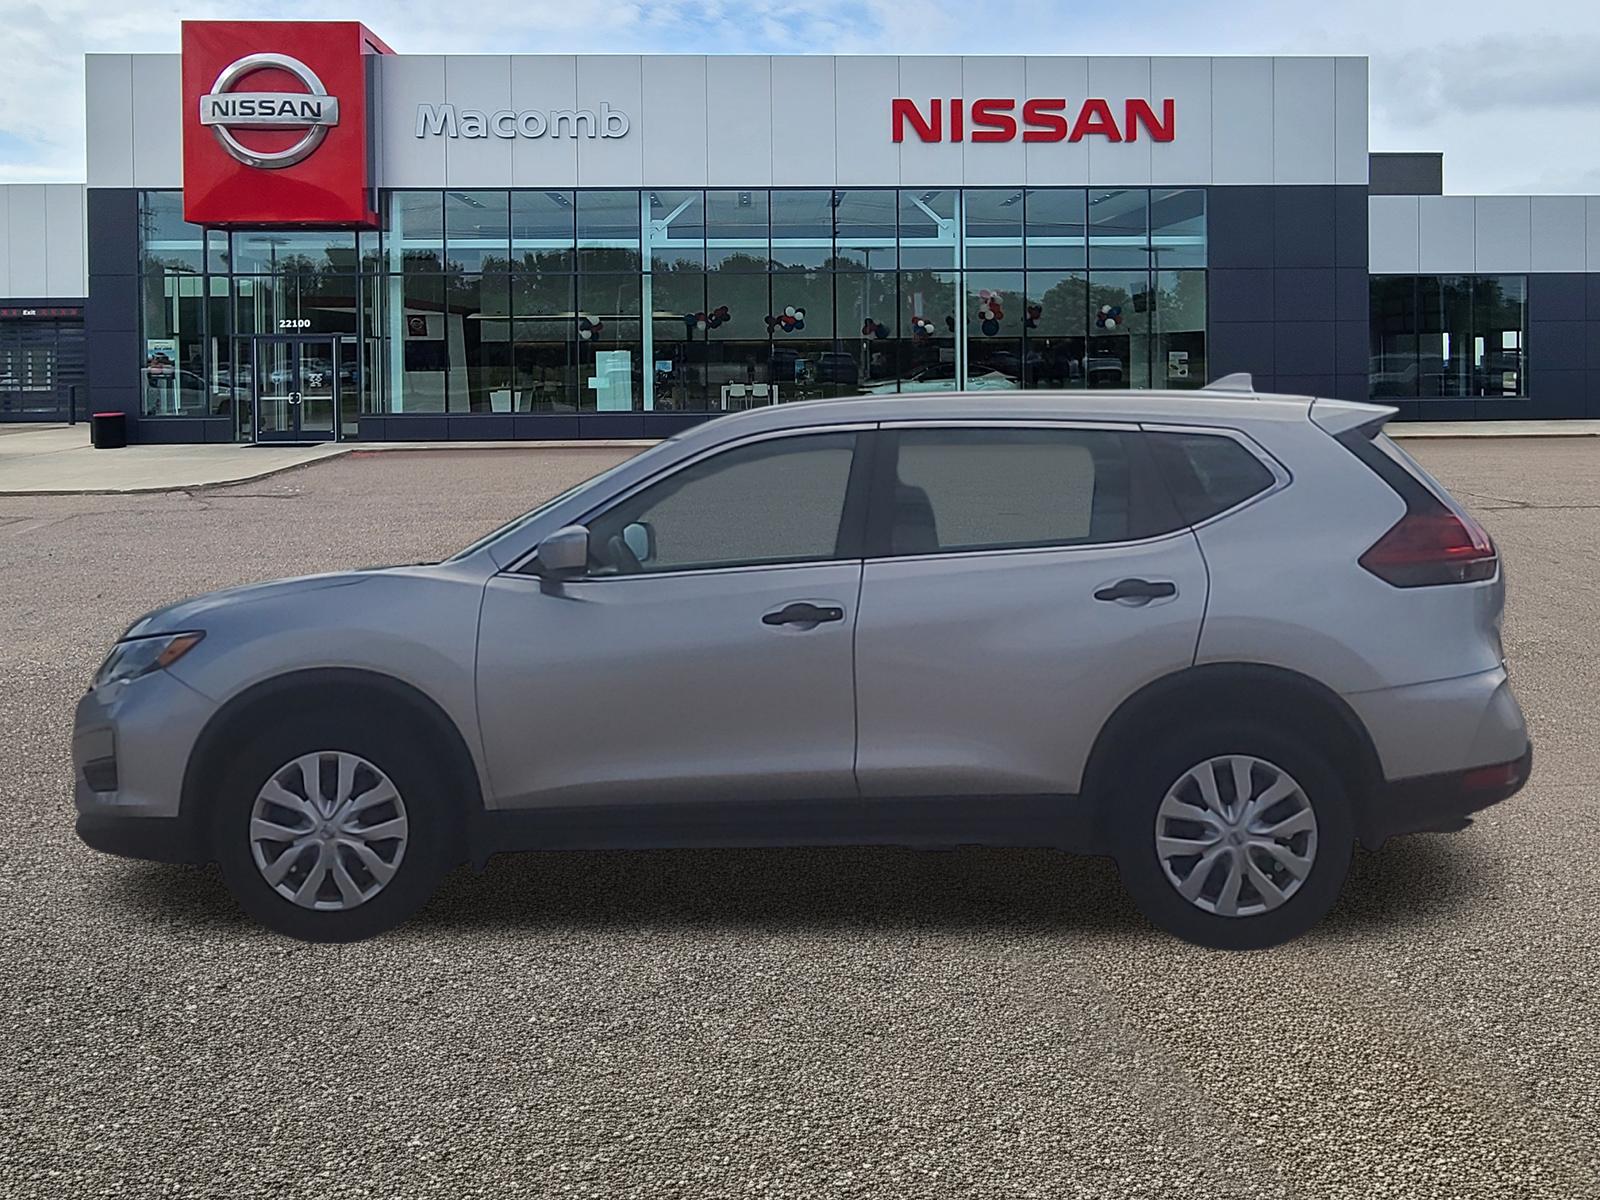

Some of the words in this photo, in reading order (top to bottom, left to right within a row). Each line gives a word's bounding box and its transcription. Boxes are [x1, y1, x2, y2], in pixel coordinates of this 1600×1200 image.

[211, 99, 322, 118] NISSAN
[415, 102, 630, 139] Macomb
[891, 98, 1175, 143] NISSAN
[279, 319, 311, 328] 22100
